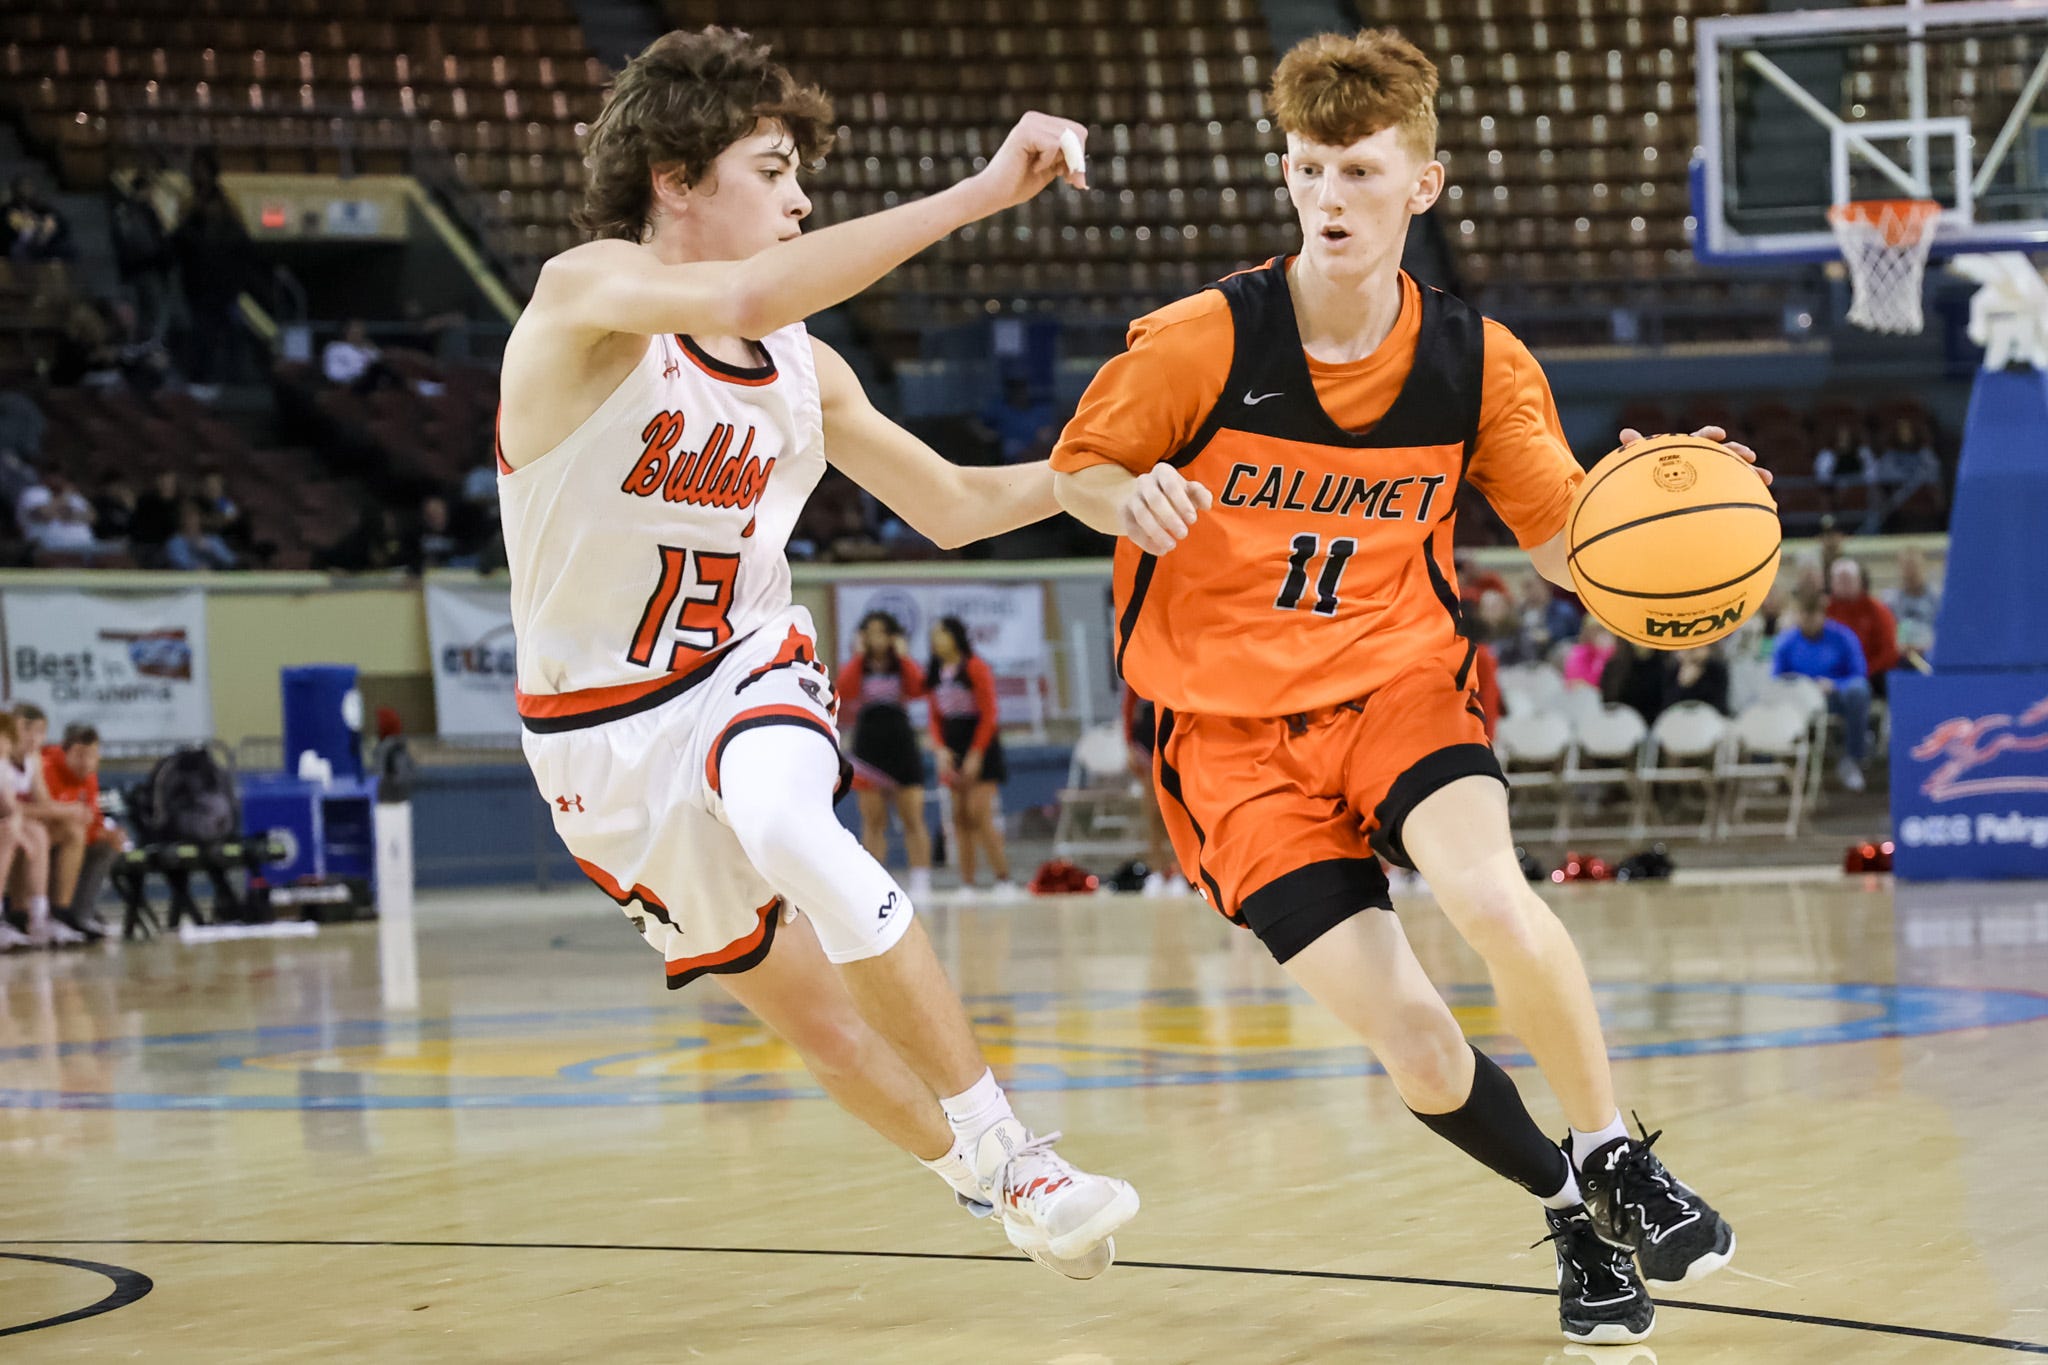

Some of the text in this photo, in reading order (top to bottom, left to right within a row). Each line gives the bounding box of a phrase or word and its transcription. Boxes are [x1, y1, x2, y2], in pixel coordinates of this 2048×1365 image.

[1220, 462, 1446, 523] CALUMET
[1273, 532, 1358, 617] 11
[626, 544, 741, 673] 13
[1646, 600, 1745, 638] NCAA
[15, 647, 95, 683] Best
